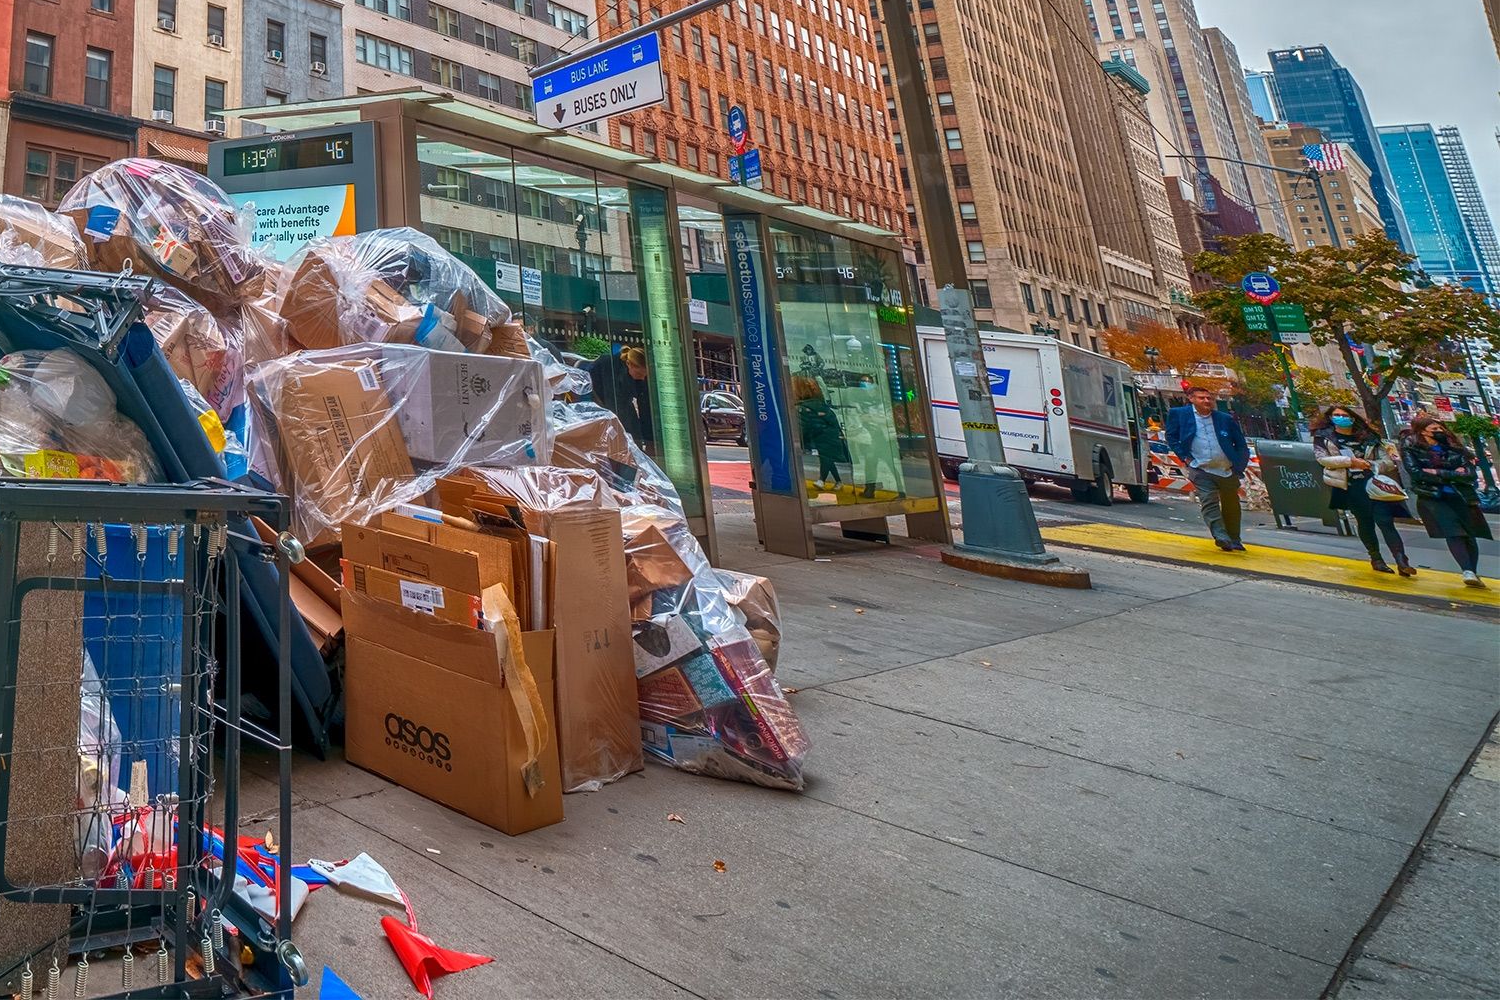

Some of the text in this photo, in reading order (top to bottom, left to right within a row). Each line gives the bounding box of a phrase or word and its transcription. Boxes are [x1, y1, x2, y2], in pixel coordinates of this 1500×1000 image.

[570, 59, 609, 83] BUS LANE
[573, 81, 637, 116] BUSES ONLY
[278, 203, 330, 216] Advantage
[259, 216, 320, 229] with benefits
[297, 230, 317, 241] use!
[1243, 305, 1263, 313] QM10
[1248, 322, 1268, 330] QM24
[751, 352, 763, 378] Park
[460, 363, 470, 405] BENANTI
[755, 381, 768, 422] Avenue
[385, 712, 451, 761] asos
[758, 721, 784, 759] DIGIORNO
